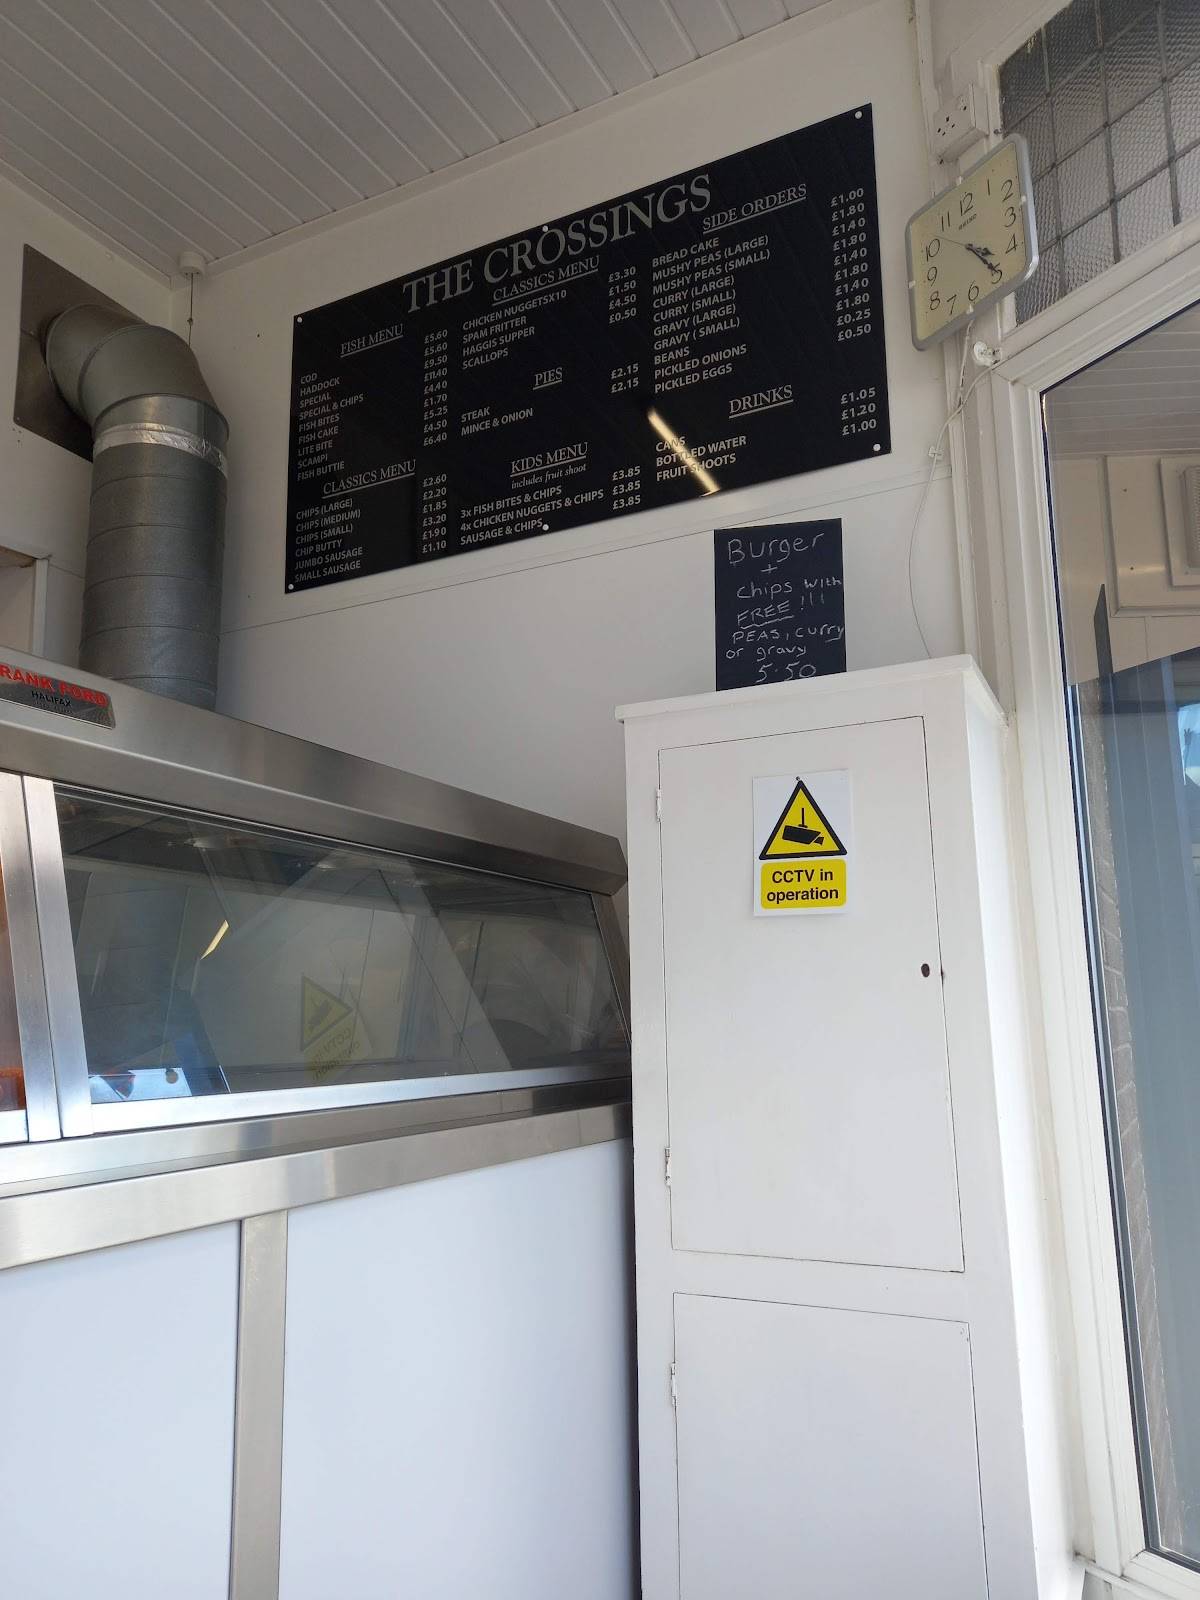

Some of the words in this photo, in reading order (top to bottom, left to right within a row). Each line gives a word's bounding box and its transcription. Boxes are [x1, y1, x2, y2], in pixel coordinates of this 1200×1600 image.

[831, 188, 864, 207] £1.00
[1001, 179, 1013, 201] 2
[703, 208, 737, 230] SIDE
[741, 183, 806, 216] ORDERS
[832, 203, 864, 221] £1.80
[959, 191, 973, 216] 12
[1004, 206, 1017, 228] 3
[832, 218, 865, 236] £1.40
[403, 259, 473, 313] THE
[484, 174, 710, 283] CROSSINGS
[833, 232, 866, 251] £1.80
[925, 238, 942, 262] 10
[1005, 233, 1018, 255] 4
[652, 248, 688, 267] BREAD
[691, 237, 719, 254] CAKE
[653, 260, 691, 281] MUSHY
[694, 250, 721, 267] PEAS
[724, 235, 768, 258] (LARGE)
[834, 248, 867, 266] £1.40
[493, 271, 554, 301] CLASSICS
[558, 255, 599, 280] MENU
[608, 266, 636, 282] £3.30
[653, 274, 691, 295] MUSHY
[695, 265, 722, 281] PEAS
[725, 249, 770, 273] (SMALL)
[835, 262, 868, 281] £1.80
[609, 280, 636, 296] £1.50
[653, 289, 688, 308] CURRY
[691, 275, 734, 298] (LARGE)
[835, 278, 869, 296] £1.40
[463, 310, 502, 330] CHICKEN
[504, 290, 566, 317] NUGGETSX10
[609, 294, 636, 310] £4.50
[653, 304, 688, 322] CURRY
[692, 289, 736, 312] (SMALL)
[836, 293, 870, 311] £1.80
[929, 290, 942, 312] 8
[609, 308, 636, 324] £0.50
[654, 317, 690, 336] GRAVY
[693, 303, 736, 326] (LARGE)
[837, 308, 870, 326] £0.25
[341, 336, 365, 354] FISH
[369, 323, 403, 345] MENU
[424, 329, 448, 344] £5.60
[463, 328, 487, 344] SPAM
[490, 316, 526, 335] FRITTER
[654, 332, 690, 350] GRAVY
[699, 317, 740, 337] SMALL)
[838, 324, 871, 341] £0.50
[424, 342, 447, 356] £5.60
[463, 338, 497, 356] HAGGIS
[499, 326, 535, 344] SUPPER
[424, 355, 447, 369] £9.50
[463, 348, 508, 369] SCALLOPS
[654, 346, 690, 365] BEANS
[655, 358, 699, 379] PICKLED
[702, 344, 746, 365] ONIONS
[301, 373, 317, 384] COD
[535, 367, 562, 386] PIES
[611, 363, 638, 379] £2.15
[655, 373, 700, 393] PICKLED
[703, 363, 732, 380] EGGS
[300, 377, 340, 396] HADDOCK
[424, 380, 447, 395] £4.40
[611, 377, 638, 393] £2.15
[300, 392, 331, 408] SPECIAL
[424, 394, 447, 407] £1.70
[729, 385, 792, 414] DRINKS
[841, 387, 875, 404] £1.05
[299, 404, 331, 420] SPECIAL
[340, 393, 363, 407] CHIPS
[424, 405, 448, 420] £5.25
[461, 406, 490, 422] STEAK
[842, 403, 875, 420] £1.20
[299, 420, 316, 432] FISH
[318, 413, 340, 426] BITES
[424, 419, 447, 433] £4.50
[461, 420, 490, 436] MINCE
[492, 418, 499, 427] &
[501, 408, 533, 424] ONION
[842, 419, 876, 435] £1.00
[299, 432, 316, 444] FISH
[317, 426, 338, 438] CAKE
[424, 432, 447, 446] £6.40
[656, 435, 686, 453] CANS
[708, 436, 746, 453] WATER
[298, 445, 314, 456] LITE
[316, 439, 332, 451] BITE
[298, 453, 328, 469] SCAMPI
[512, 454, 542, 473] KIDS
[547, 442, 587, 464] MENU
[297, 469, 314, 481] FISH
[317, 461, 344, 476] BUTTIE
[323, 470, 377, 494] CLASSICS
[380, 459, 416, 479] MENU
[512, 474, 542, 489] includes
[545, 470, 563, 483] fruit
[565, 464, 586, 475] shoot
[612, 466, 640, 481] £3.85
[656, 465, 687, 483] FRUIT
[690, 452, 737, 475] SHOOTS
[423, 474, 447, 487] £2.60
[613, 480, 640, 495] £3.85
[423, 487, 446, 500] £2.20
[461, 510, 471, 518] 3x
[474, 502, 494, 515] FISH
[496, 495, 522, 509] BITES
[524, 494, 531, 502] &
[533, 485, 562, 500] CHIPS
[613, 495, 640, 510] £3.85
[296, 507, 319, 520] CHIPS
[321, 498, 352, 514] (LARGE)
[423, 500, 447, 513] £1.85
[460, 523, 471, 531] 4x
[473, 511, 514, 528] CHICKEN
[516, 499, 562, 518] NUGGETS
[564, 497, 572, 506] &
[574, 489, 603, 504] CHIPS
[296, 519, 319, 532] CHIPS
[321, 509, 360, 527] (MEDIUM)
[423, 514, 446, 527] £3.20
[296, 532, 319, 544] CHIPS
[321, 523, 353, 539] (SMALL)
[423, 527, 446, 540] £1.90
[461, 527, 503, 545] SAUSAGE
[505, 526, 512, 534] &
[514, 518, 542, 532] CHIPS
[295, 546, 314, 557] CHIP
[316, 539, 342, 552] BUTTY
[422, 540, 446, 553] £1.10
[728, 533, 825, 563] Burger
[295, 556, 323, 570] JUMBO
[325, 547, 363, 563] SAUSAGE
[295, 570, 321, 582] SMALL
[323, 560, 360, 576] SAUSAGE
[737, 600, 791, 626] FREE
[795, 624, 845, 643] curry
[726, 647, 744, 660] or
[757, 645, 807, 662] gravy
[31, 690, 71, 708] HALIFAX
[772, 869, 815, 884] CCTV
[820, 868, 834, 882] in
[767, 887, 839, 904] operation
